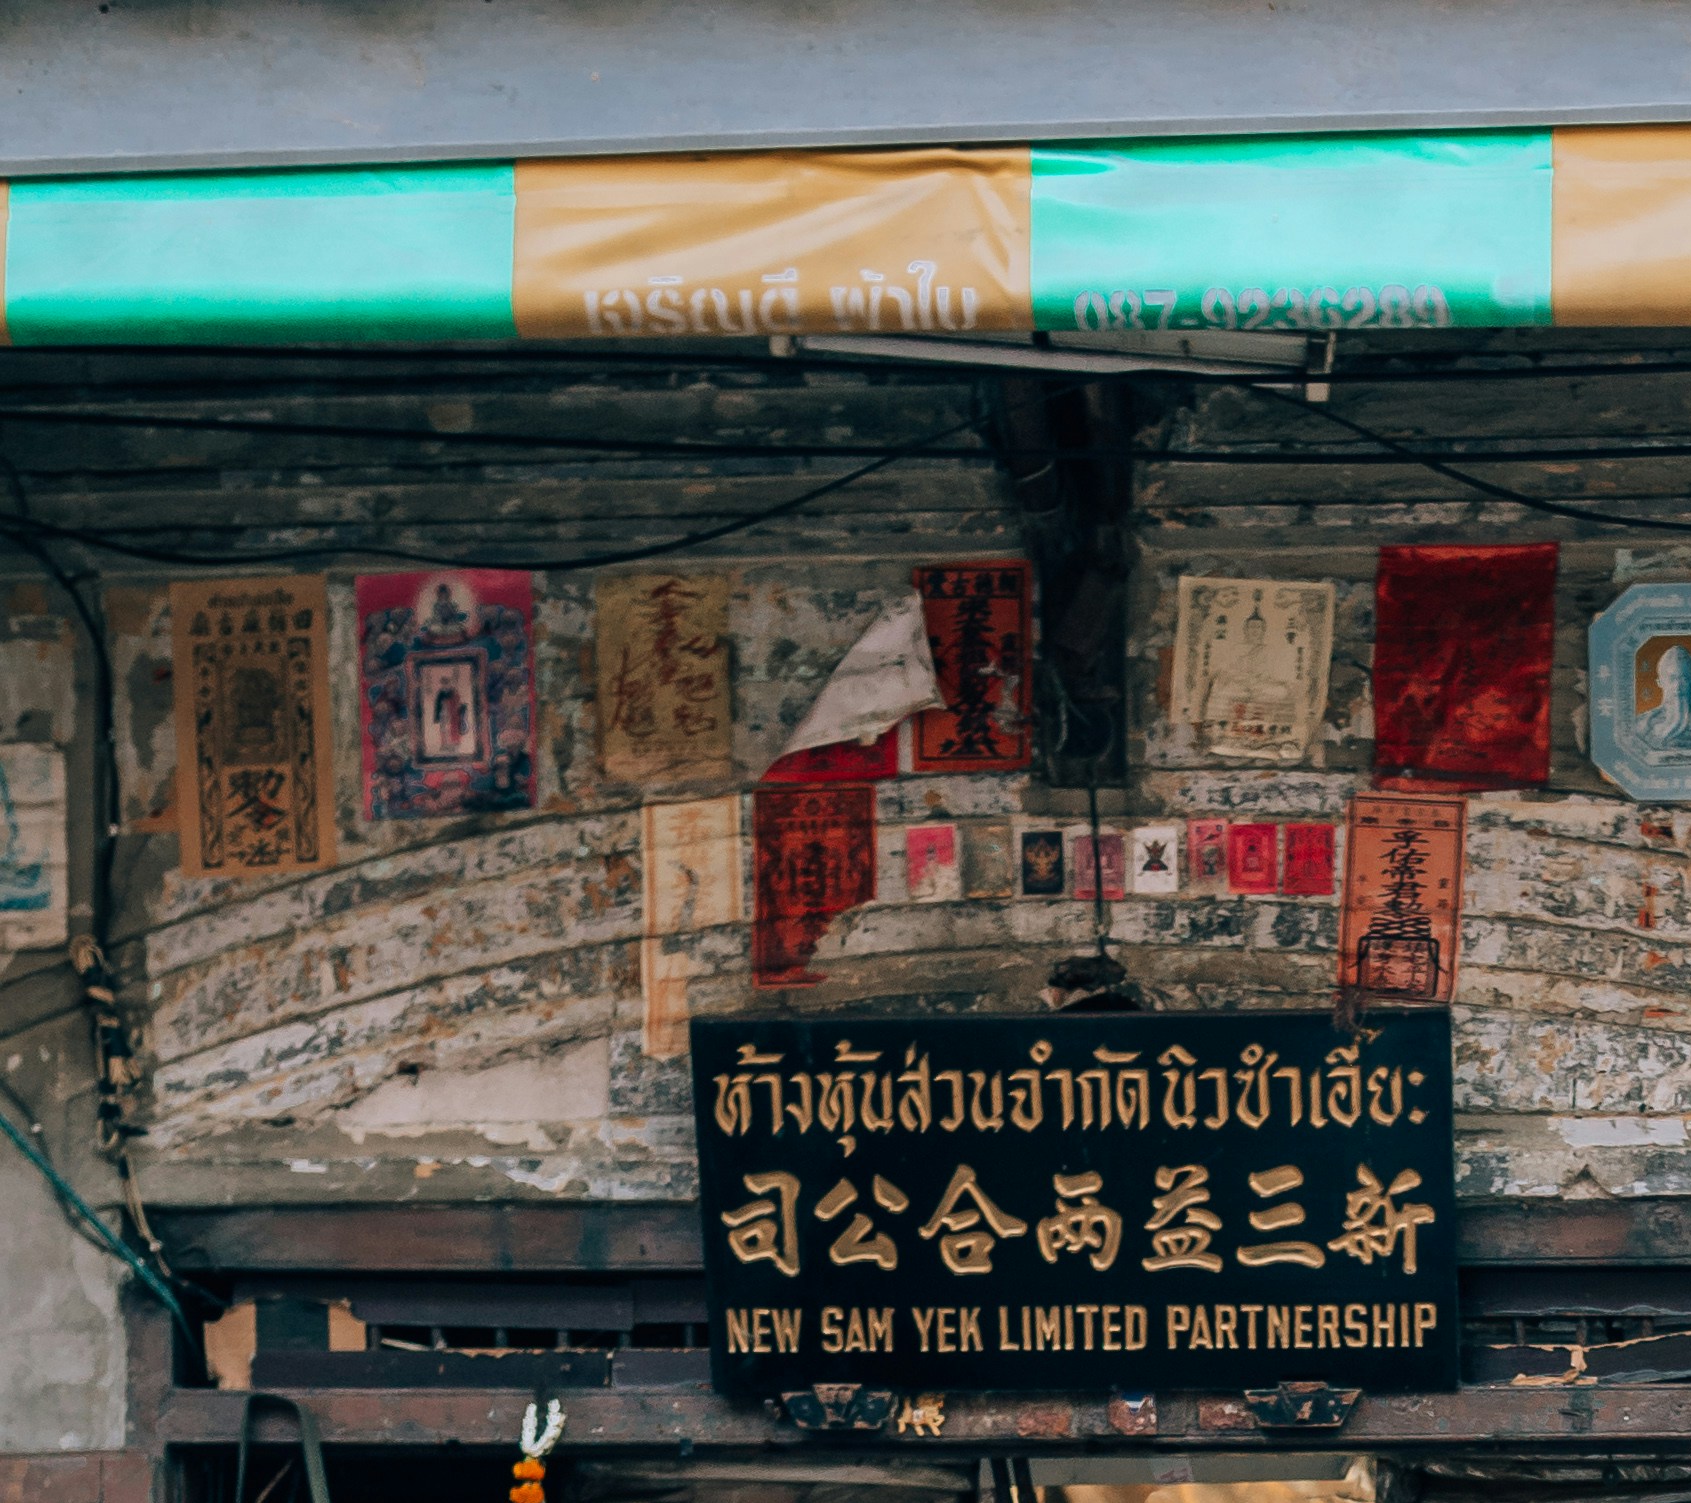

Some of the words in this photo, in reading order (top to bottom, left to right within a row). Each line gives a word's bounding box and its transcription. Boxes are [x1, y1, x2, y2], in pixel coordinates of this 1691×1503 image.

[726, 1308, 801, 1354] NEW
[821, 1308, 895, 1353] SAM
[911, 1307, 985, 1353] YEK
[999, 1305, 1149, 1352] LIMITED
[1166, 1303, 1439, 1351] PARTNERSHIP
